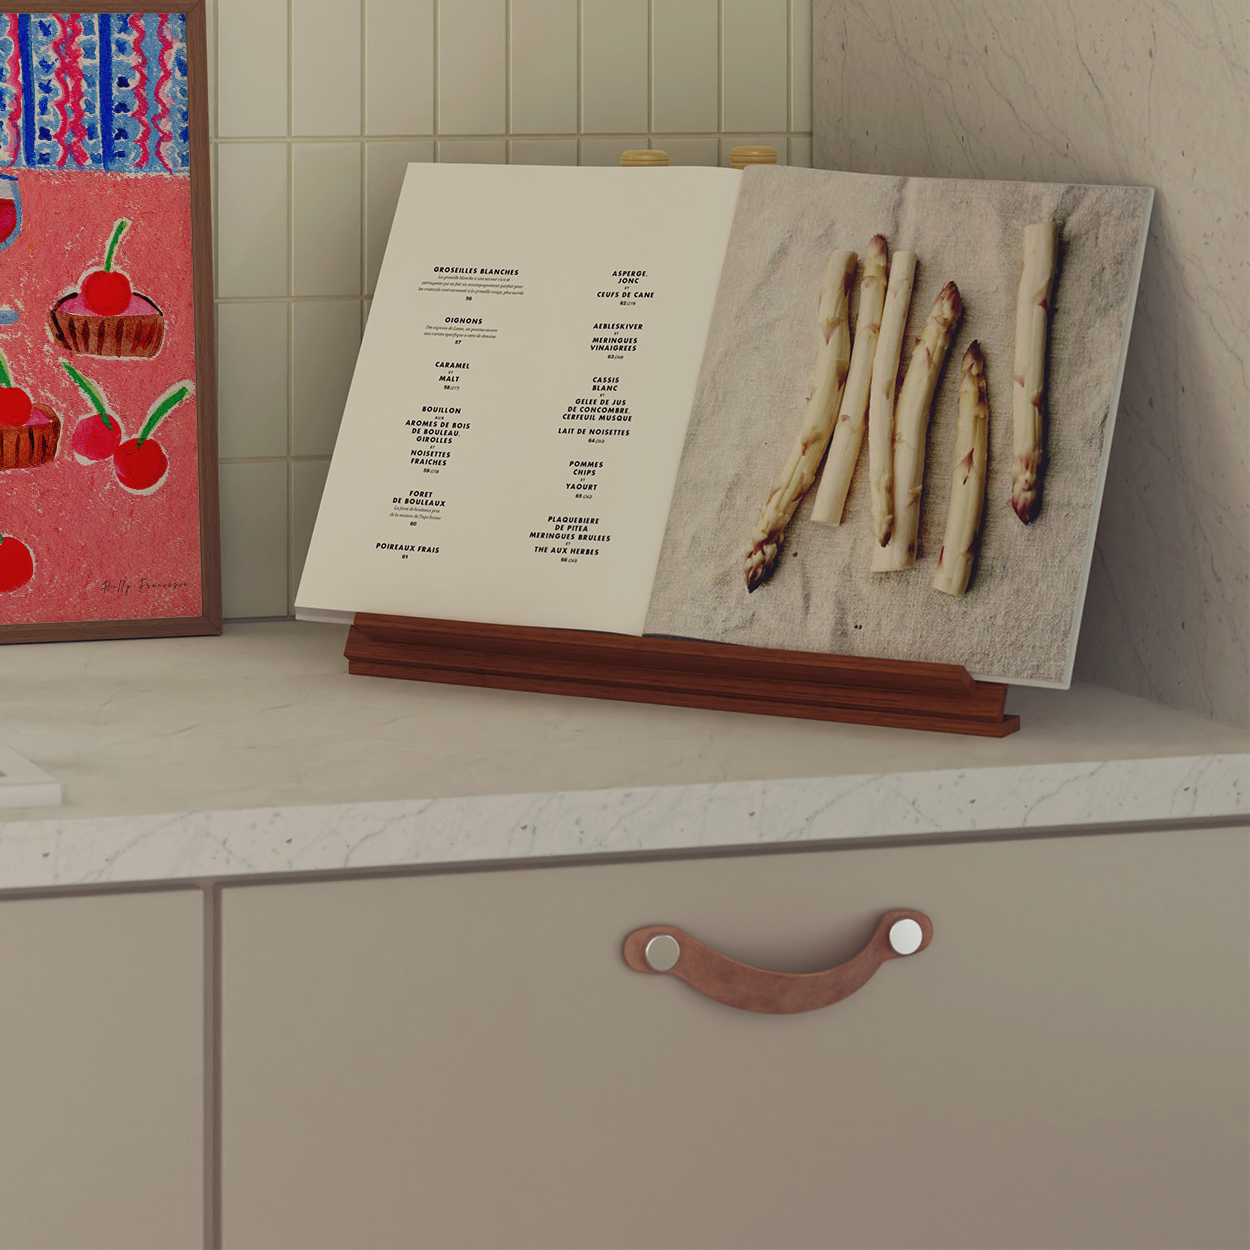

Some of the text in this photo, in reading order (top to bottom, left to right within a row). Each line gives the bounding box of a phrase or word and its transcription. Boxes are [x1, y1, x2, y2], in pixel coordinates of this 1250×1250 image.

[434, 266, 519, 276] GROSEILLES BLANCHES
[445, 317, 483, 325] OIGNONS
[435, 361, 470, 370] CARAMEL
[592, 376, 620, 384] CASSIS
[421, 406, 461, 414] BOUILLON
[405, 420, 438, 428] AROMES
[452, 422, 471, 430] BOIS
[416, 436, 453, 444] GIROLLES
[410, 450, 451, 458] NOISETTES
[410, 458, 447, 466] FRAICHES
[568, 460, 604, 468] POMMES
[566, 483, 598, 491] YAOURT
[409, 490, 433, 498] FORET
[404, 498, 446, 507] BOULEAUX
[547, 516, 600, 524] PLAQUEBIERE
[529, 532, 611, 542] MERINGUES BRULEES
[375, 542, 440, 554] POIREAUX FRAIS
[570, 548, 600, 556] HERBES
